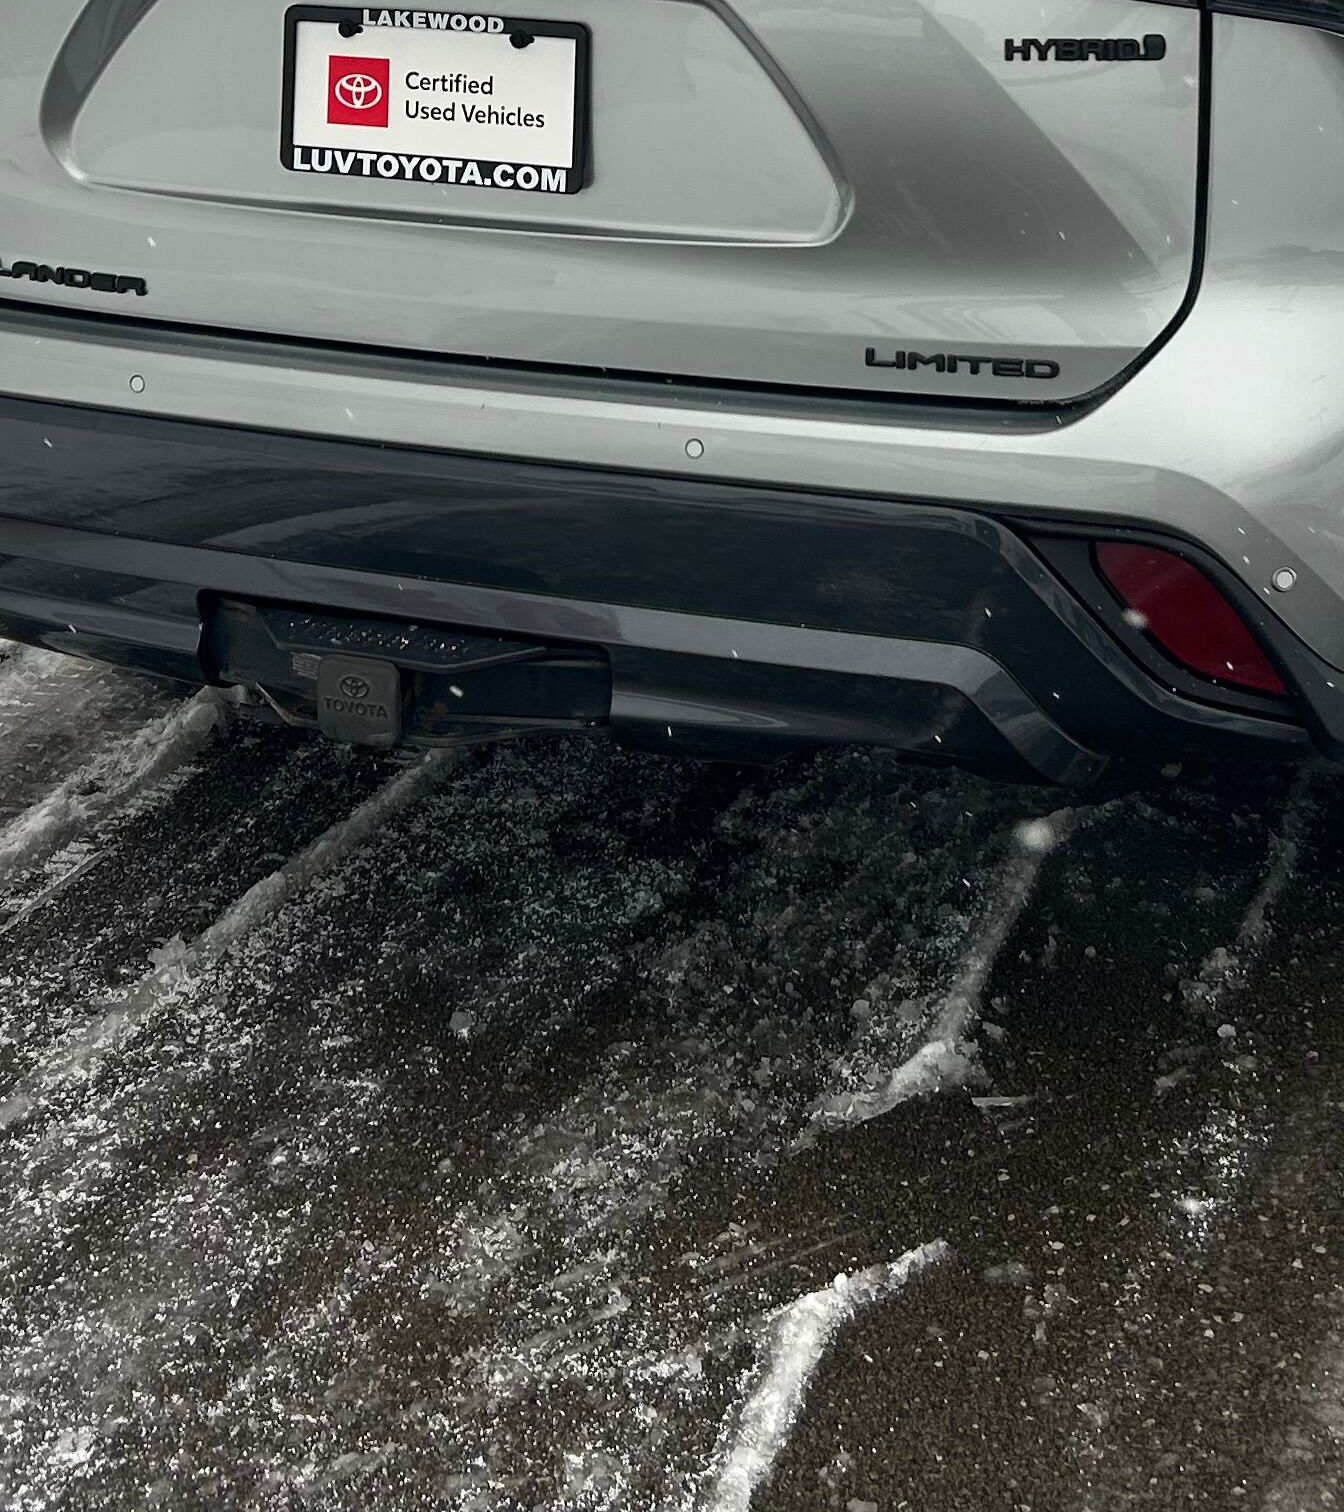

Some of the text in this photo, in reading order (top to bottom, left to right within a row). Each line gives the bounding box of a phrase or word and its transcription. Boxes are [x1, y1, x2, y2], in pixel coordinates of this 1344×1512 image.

[362, 9, 505, 33] LAKEWOOD
[1004, 38, 1140, 61] HYBRID
[405, 72, 494, 95] Certified
[405, 101, 545, 128] Used Vehicles
[293, 147, 567, 193] LUVTOYOTA.COM
[865, 347, 1060, 378] LIMITED
[324, 696, 388, 719] TOYOTA
